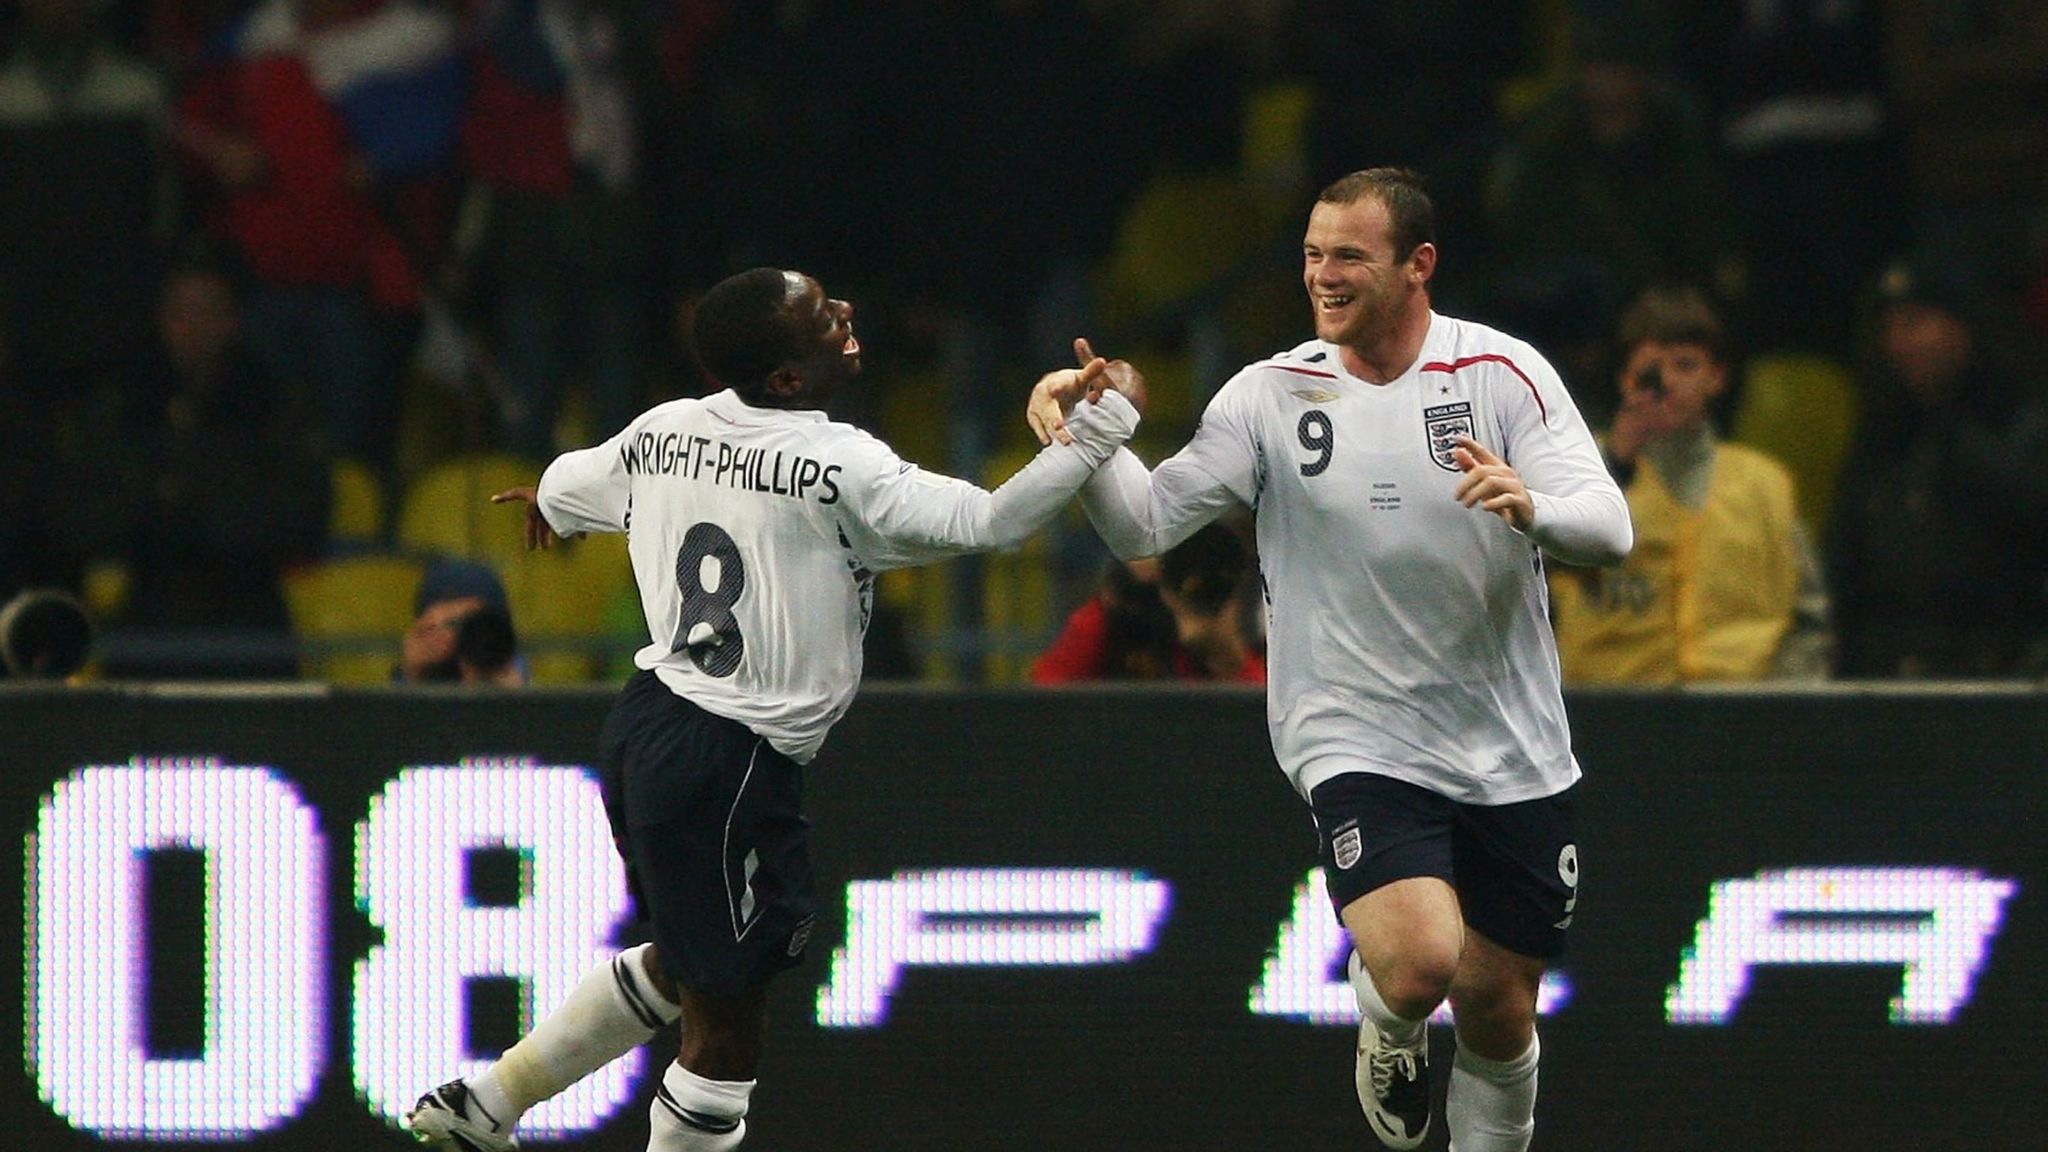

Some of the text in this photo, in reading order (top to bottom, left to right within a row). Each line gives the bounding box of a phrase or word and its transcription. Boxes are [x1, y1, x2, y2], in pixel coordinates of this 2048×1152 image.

[1297, 409, 1334, 477] 9
[1426, 403, 1469, 417] ENGLAND
[621, 431, 843, 504] WRIGHT-PHILLIPS
[671, 521, 746, 678] 8
[1557, 843, 1579, 913] 9
